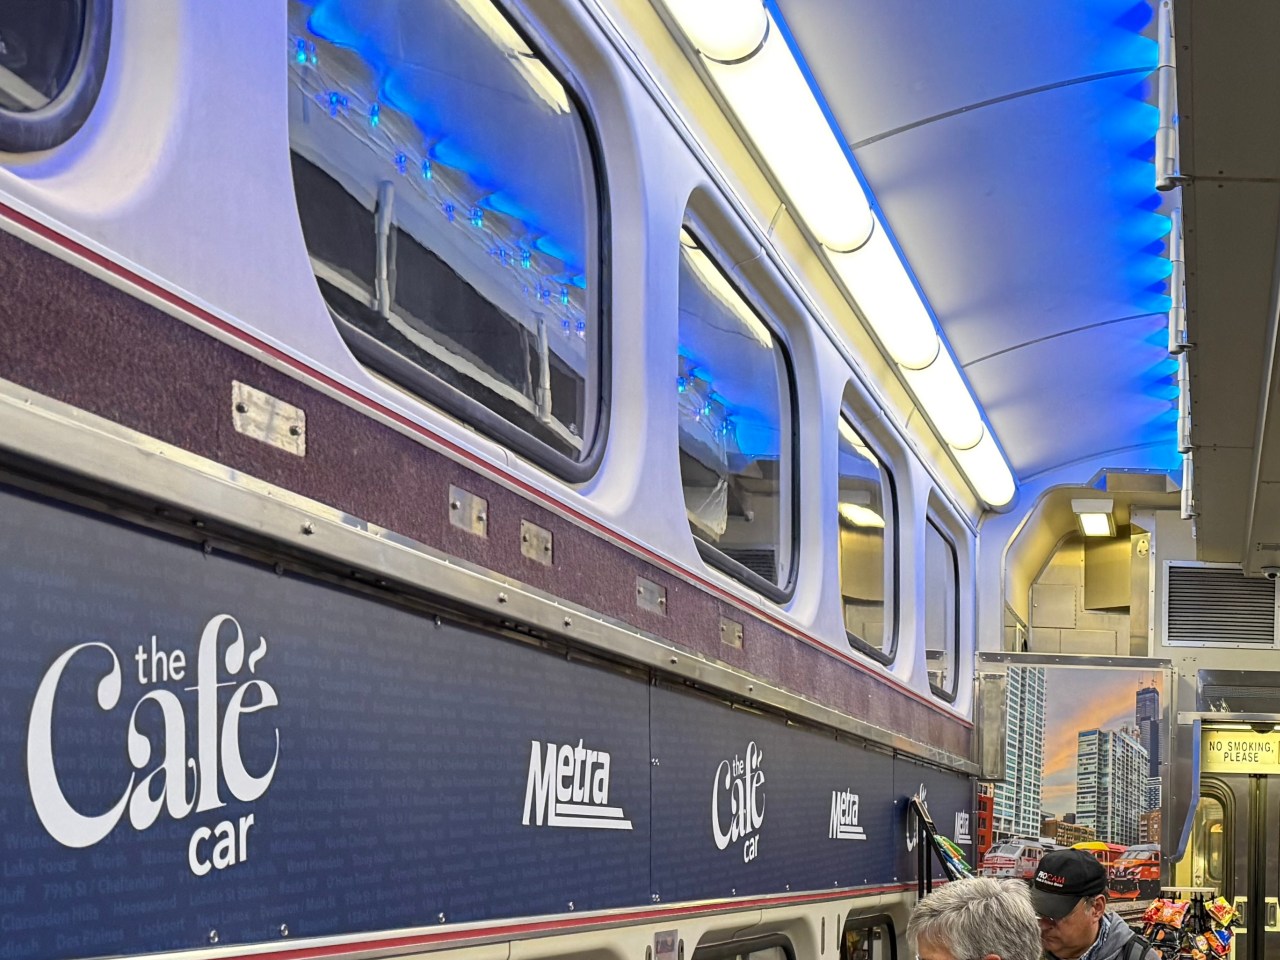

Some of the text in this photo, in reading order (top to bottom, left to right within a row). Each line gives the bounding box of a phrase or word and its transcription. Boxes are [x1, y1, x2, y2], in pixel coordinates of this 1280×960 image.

[134, 636, 186, 685] the
[26, 613, 279, 849] Café
[1209, 741, 1274, 753] NO SMOKING,
[732, 755, 744, 776] the
[1224, 752, 1259, 762] PLEASE
[522, 738, 611, 827] Metra
[712, 741, 765, 850] Café
[829, 788, 859, 839] Metra
[954, 809, 969, 843] Metra
[188, 813, 255, 876] car
[743, 833, 759, 863] car
